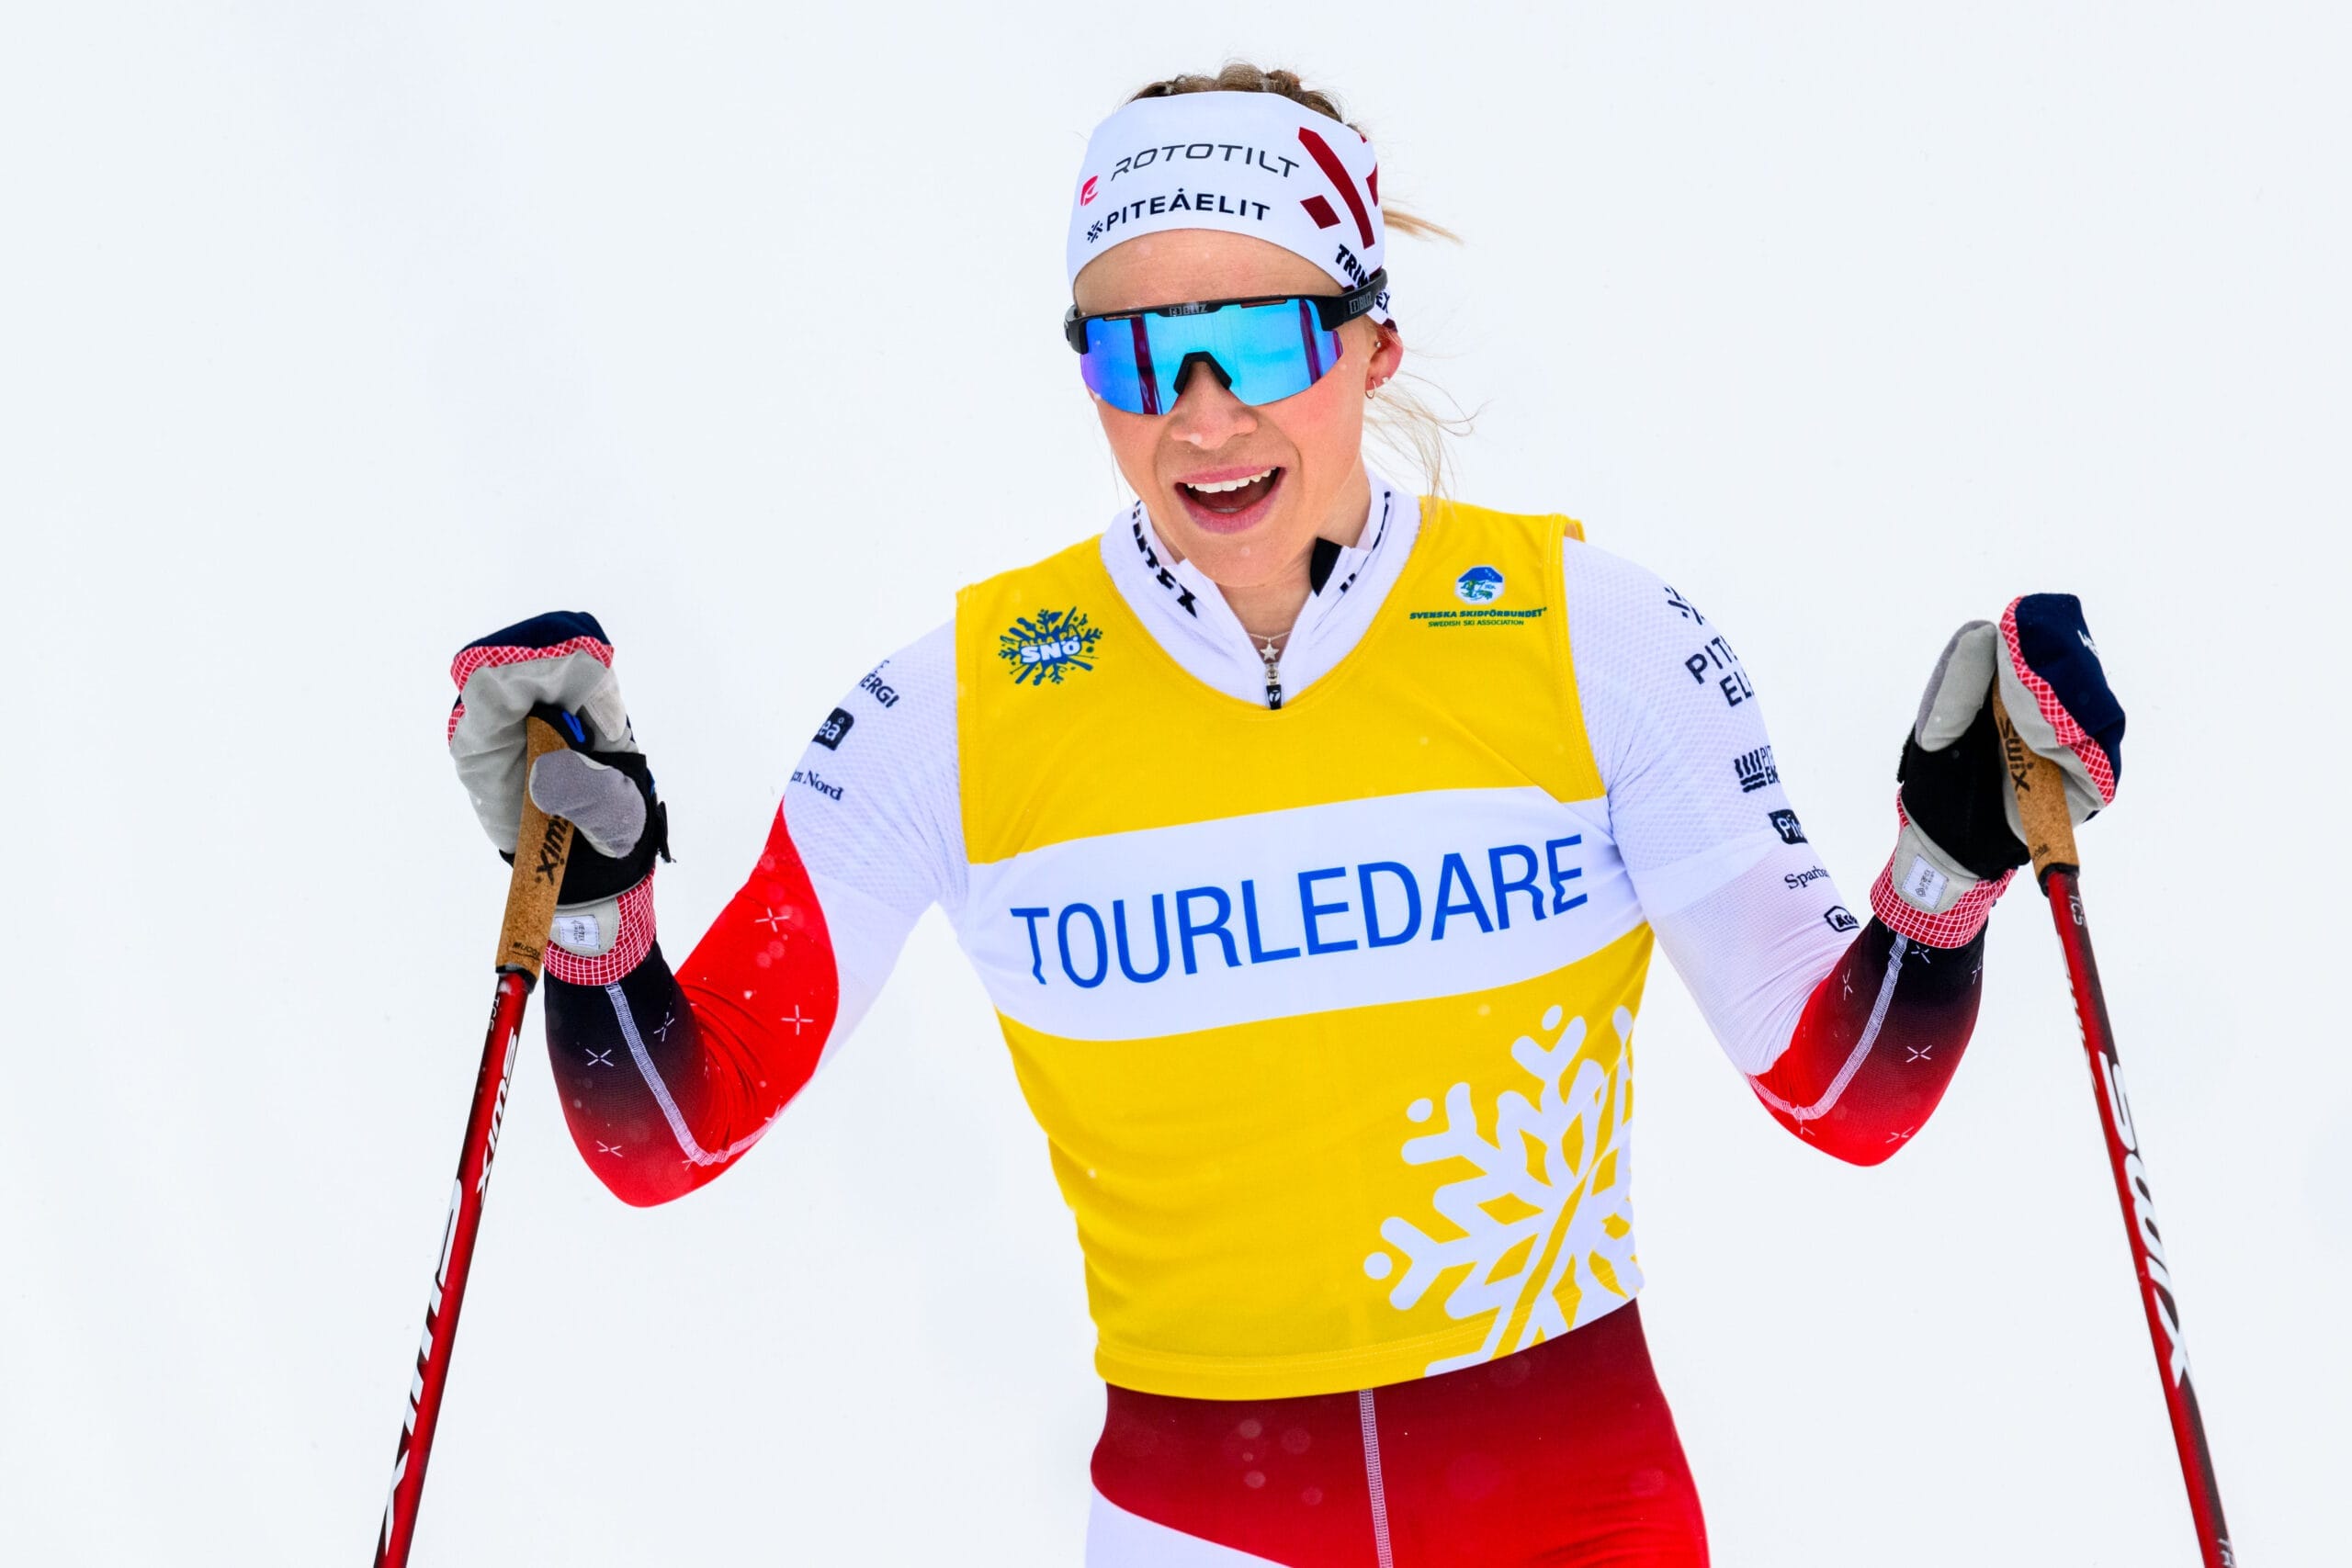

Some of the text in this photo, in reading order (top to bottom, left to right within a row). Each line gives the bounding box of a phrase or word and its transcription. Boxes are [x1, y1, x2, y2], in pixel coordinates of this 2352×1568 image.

[1110, 143, 1300, 181] ROTOTILT
[1106, 187, 1271, 231] PITEÅELIT
[1409, 607, 1544, 620] SVENSKA SKIDFÖRBUNDET
[1020, 636, 1081, 663] SNÖ
[1685, 636, 1738, 685] PIT
[802, 770, 844, 802] Nord
[537, 814, 571, 886] wix
[1009, 833, 1589, 989] TOURLEDARE
